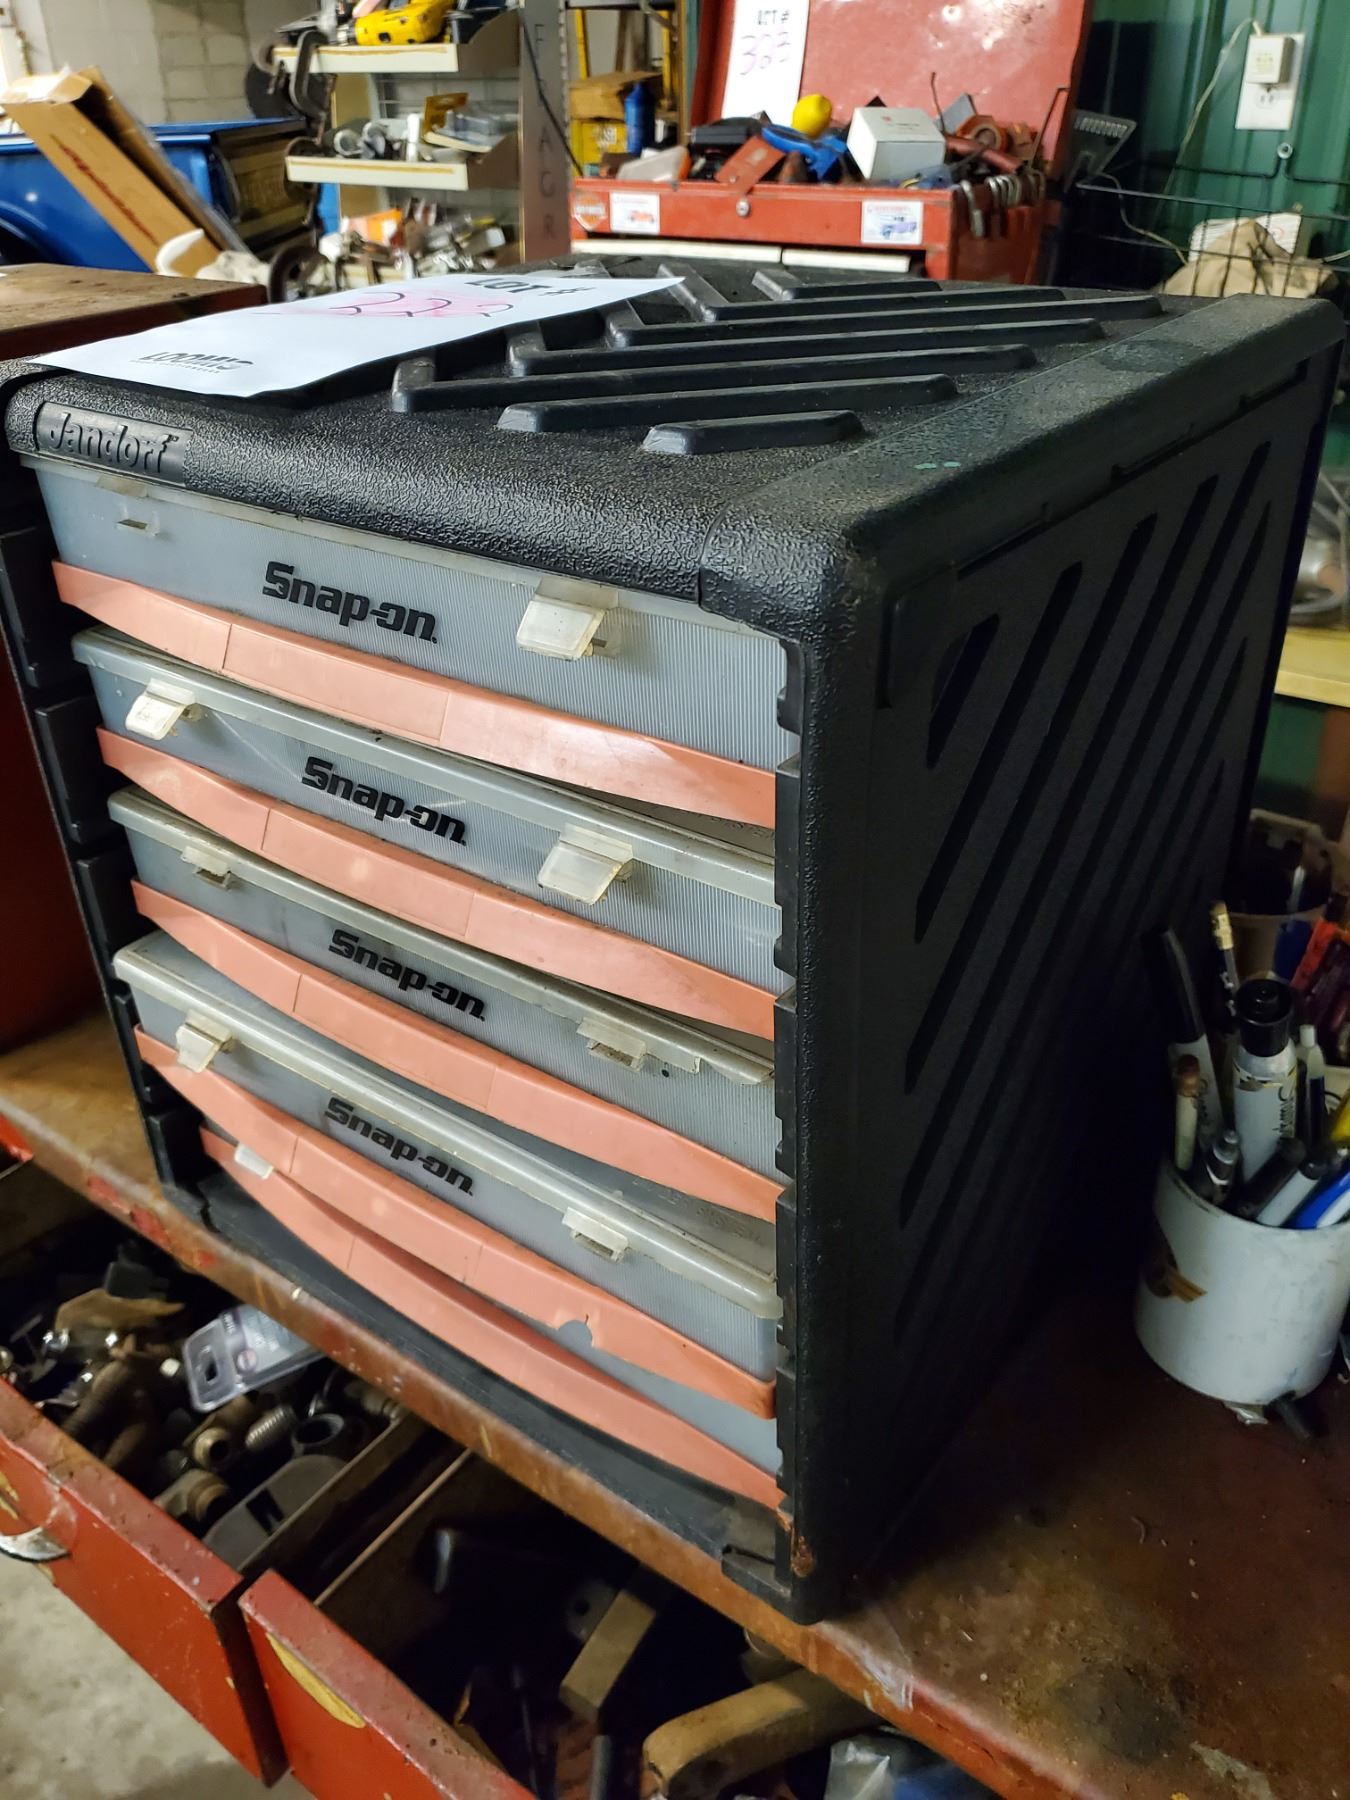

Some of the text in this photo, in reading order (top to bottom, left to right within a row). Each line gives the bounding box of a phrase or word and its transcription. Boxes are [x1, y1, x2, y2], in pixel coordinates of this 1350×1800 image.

[465, 278, 549, 293] LOT
[262, 561, 437, 643] Snap-on
[302, 756, 466, 846] Snap-on
[329, 928, 485, 1021] Snap-on
[325, 1097, 473, 1196] Snap-on
